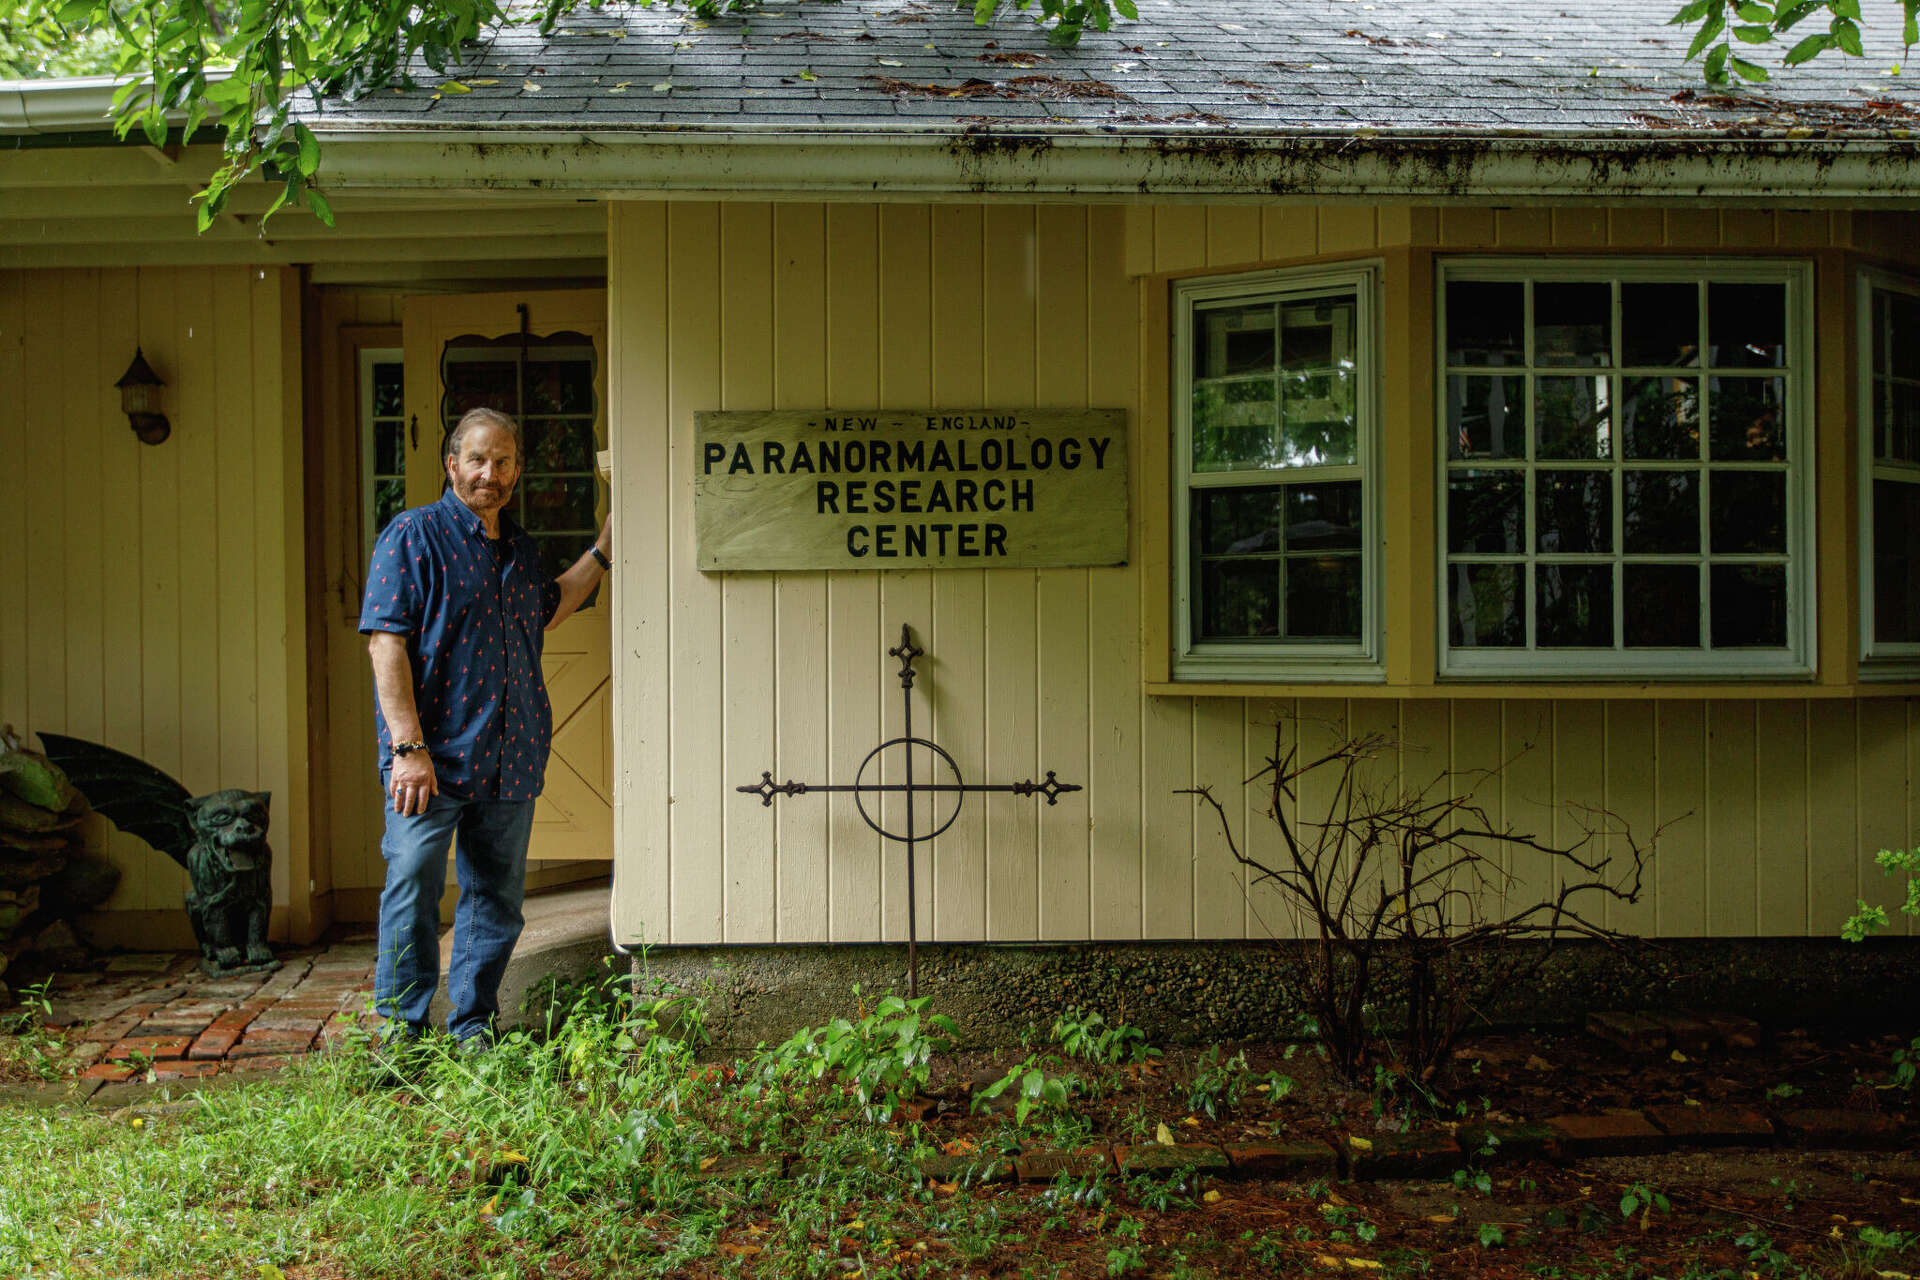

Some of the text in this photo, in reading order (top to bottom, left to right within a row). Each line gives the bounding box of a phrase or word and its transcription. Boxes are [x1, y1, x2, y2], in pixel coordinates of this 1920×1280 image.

[825, 417, 877, 431] NEW
[704, 437, 1111, 475] PARANORMALOLOGY
[817, 479, 1034, 514] RESEARCH
[847, 524, 1008, 557] CENTER
